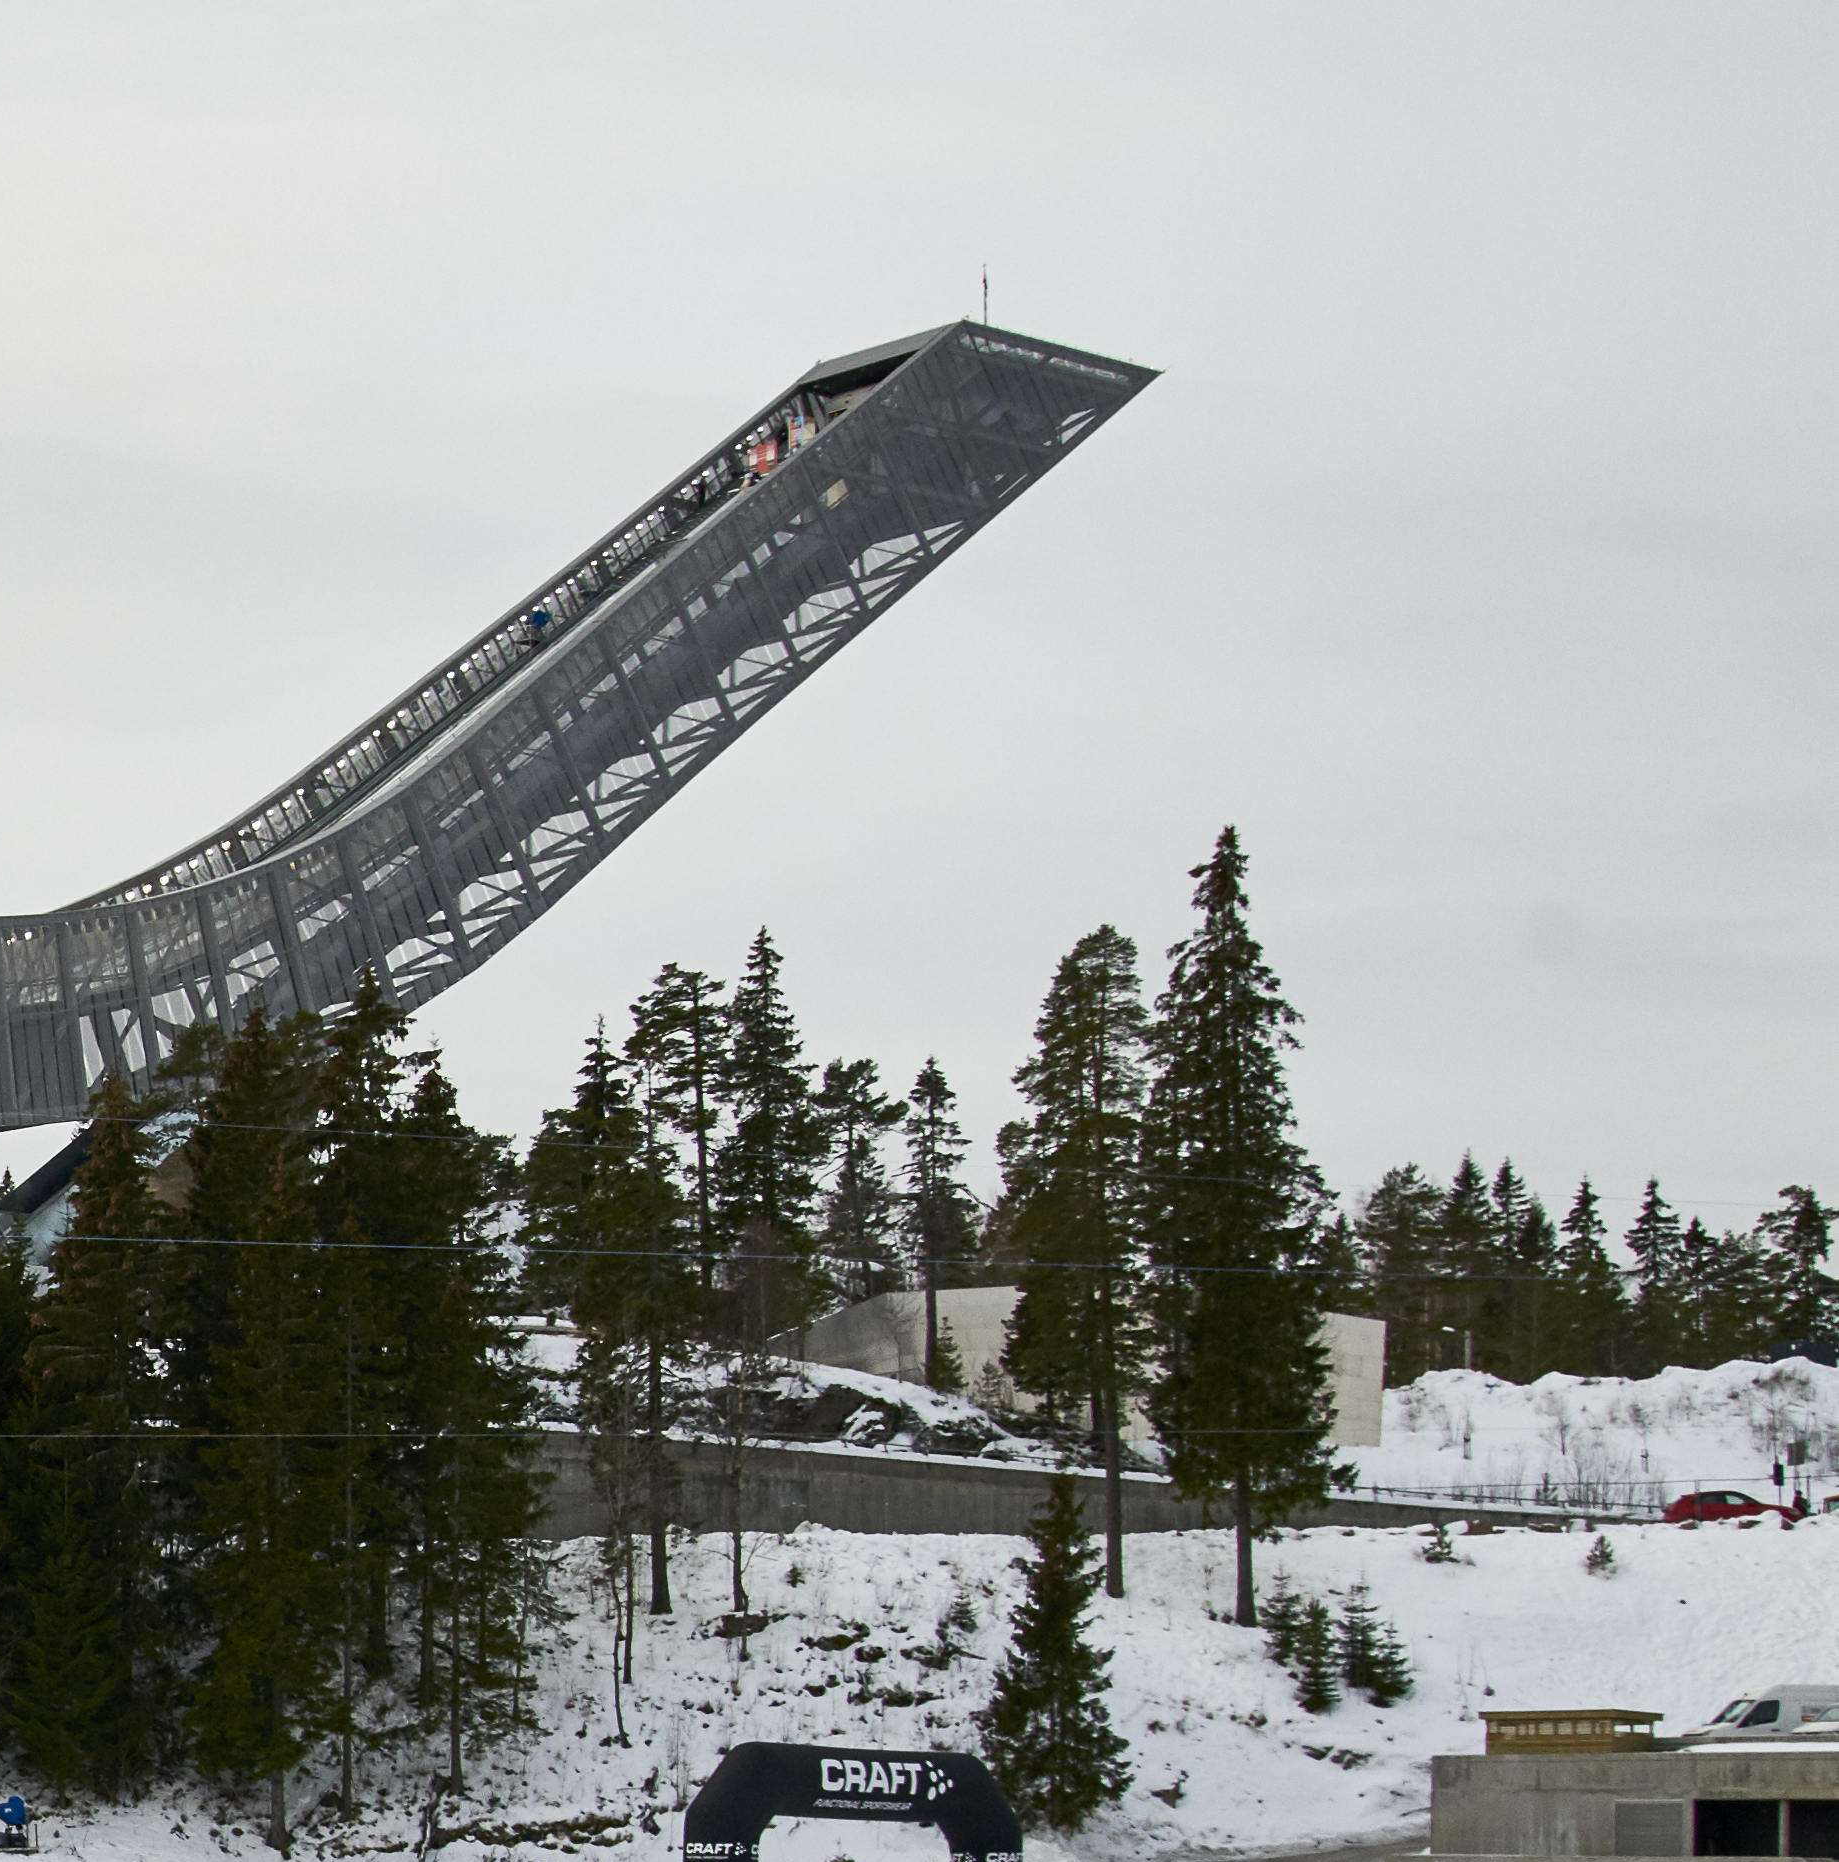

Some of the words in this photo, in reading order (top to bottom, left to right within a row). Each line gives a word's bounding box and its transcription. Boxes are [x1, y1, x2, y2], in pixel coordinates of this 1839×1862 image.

[820, 1758, 922, 1795] CRAFT
[686, 1842, 734, 1855] CRAFT
[985, 1852, 1023, 1862] CRAF
